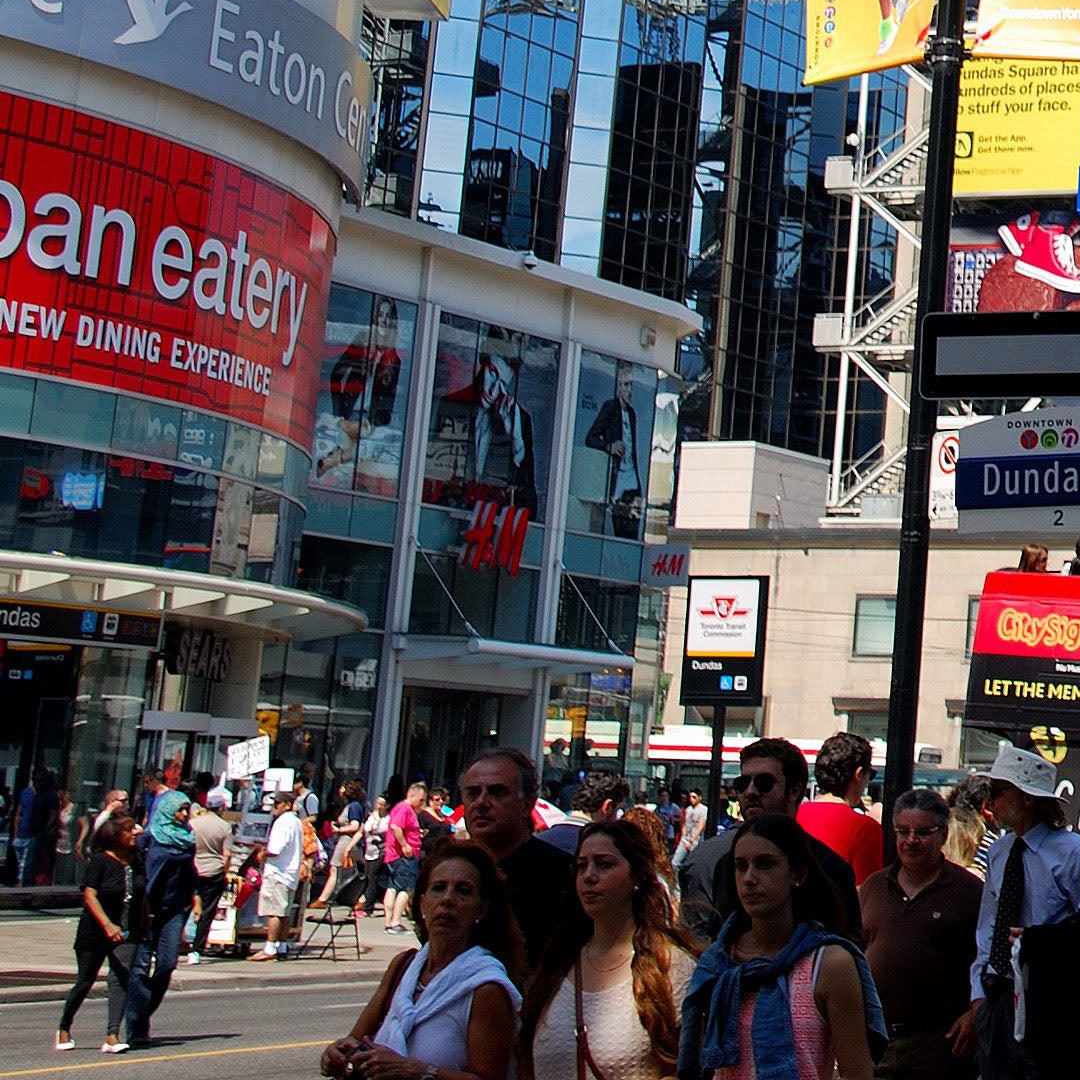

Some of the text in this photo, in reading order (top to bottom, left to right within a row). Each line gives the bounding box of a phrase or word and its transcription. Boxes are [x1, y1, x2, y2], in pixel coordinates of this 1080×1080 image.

[960, 66, 1005, 80] undas
[1008, 64, 1058, 81] Square
[959, 83, 1016, 98] undreds
[1019, 81, 1033, 96] of
[968, 99, 1001, 115] stuff
[1004, 102, 1034, 117] your
[1038, 97, 1072, 112] face.
[152, 225, 308, 368] eatery
[76, 314, 161, 363] DINING
[171, 329, 272, 398] EXPERIENCE
[1007, 419, 1073, 429] DOWNTOWN
[1053, 510, 1064, 527] 2
[176, 627, 234, 683] SEARS
[692, 660, 722, 670] Dundas
[984, 678, 1012, 696] LET
[1013, 680, 1045, 699] THE
